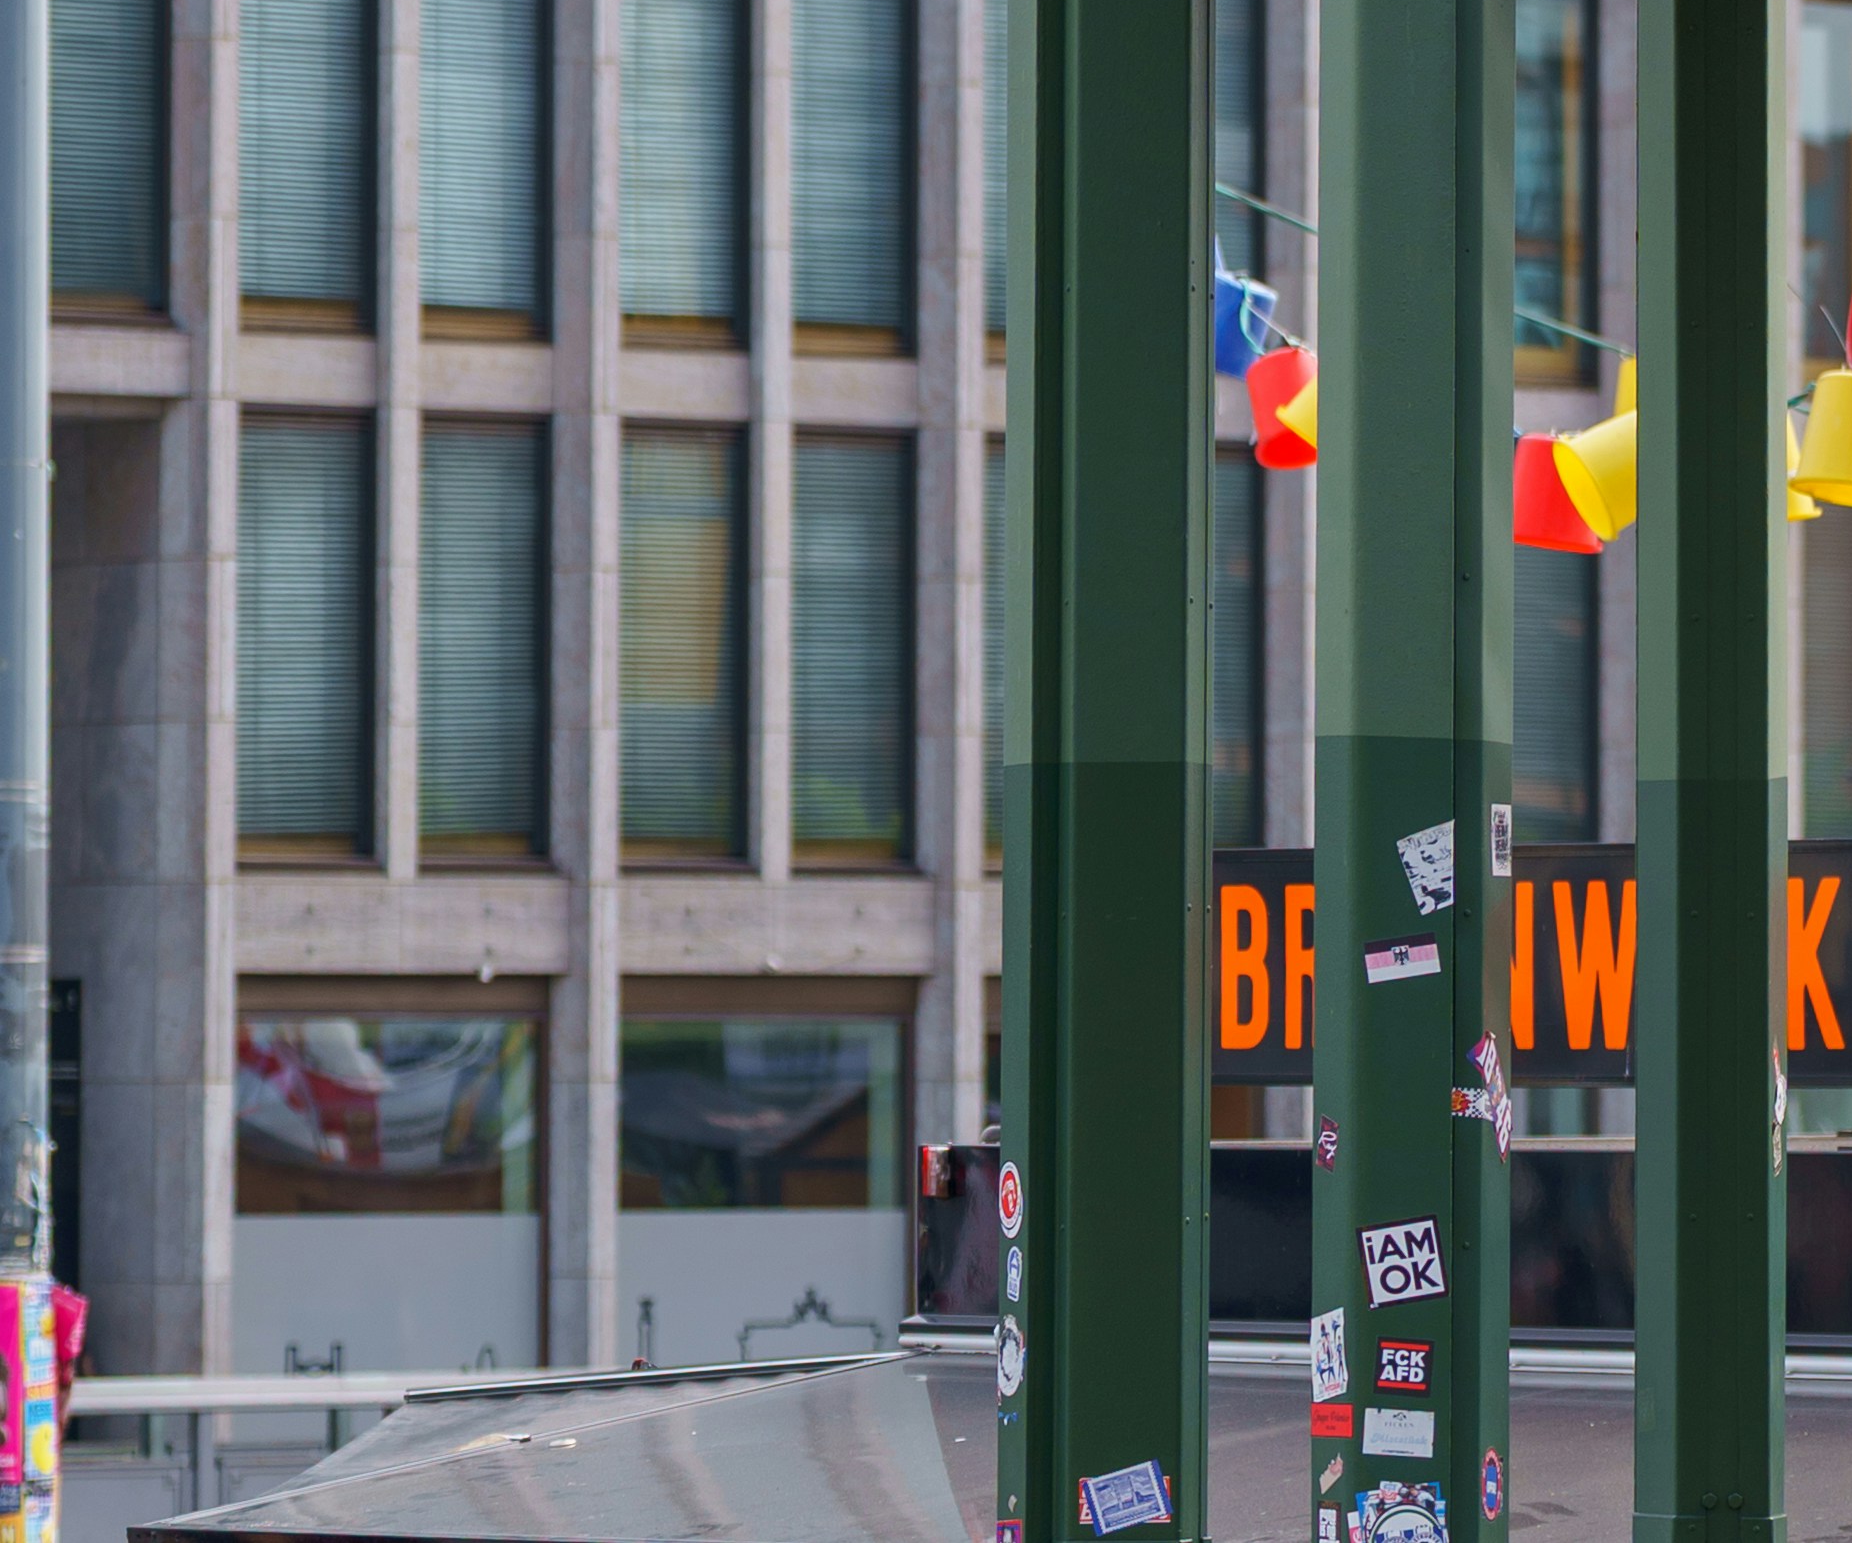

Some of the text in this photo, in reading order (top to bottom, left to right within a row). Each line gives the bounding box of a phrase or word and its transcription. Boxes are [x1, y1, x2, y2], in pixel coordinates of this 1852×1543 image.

[1379, 1257, 1441, 1295] OK
[1381, 1348, 1426, 1368] FCK
[1379, 1364, 1425, 1383] AFD
